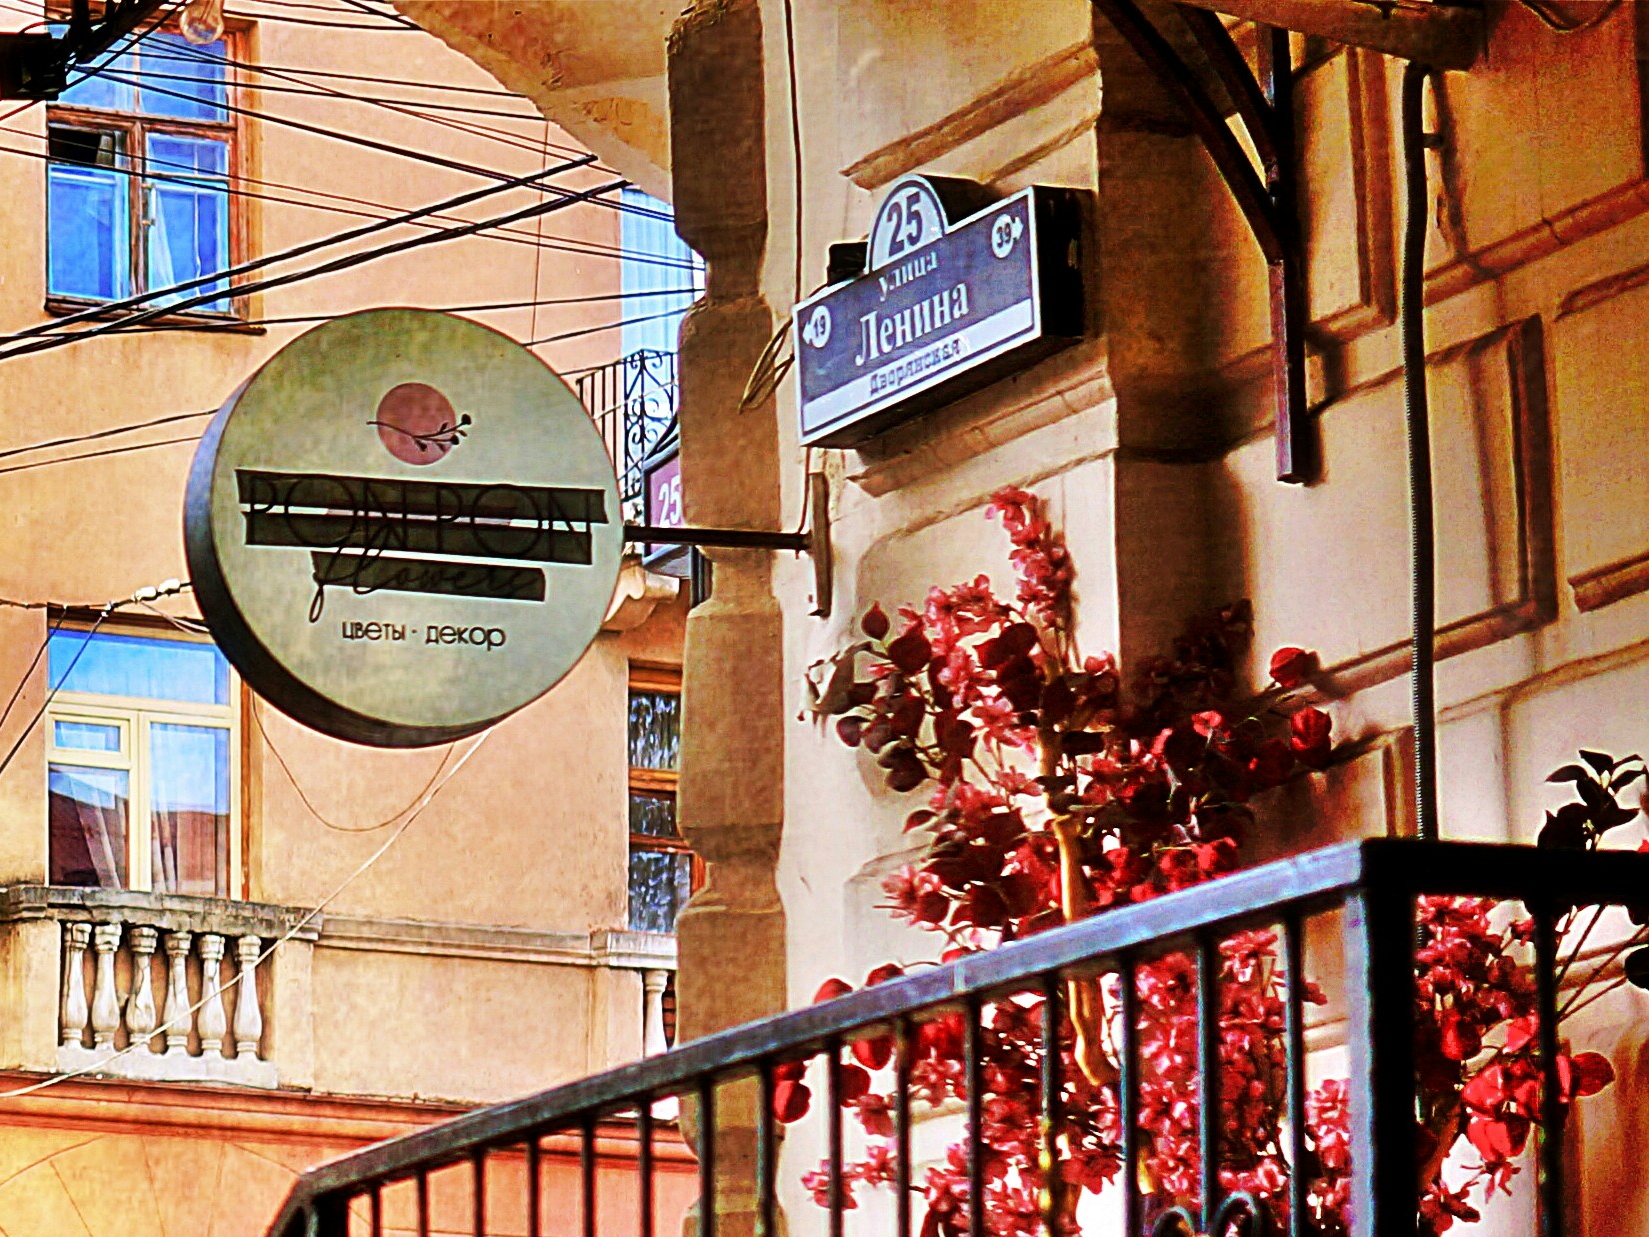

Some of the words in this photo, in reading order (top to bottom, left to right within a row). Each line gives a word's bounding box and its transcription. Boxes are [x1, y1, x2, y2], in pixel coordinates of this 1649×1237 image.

[886, 191, 923, 258] 25
[996, 222, 1012, 248] 39
[878, 249, 939, 302] улица
[813, 315, 826, 338] 19
[854, 282, 970, 367] Ленина
[658, 474, 682, 528] 25
[341, 620, 406, 641] цветы
[424, 625, 507, 652] декор
